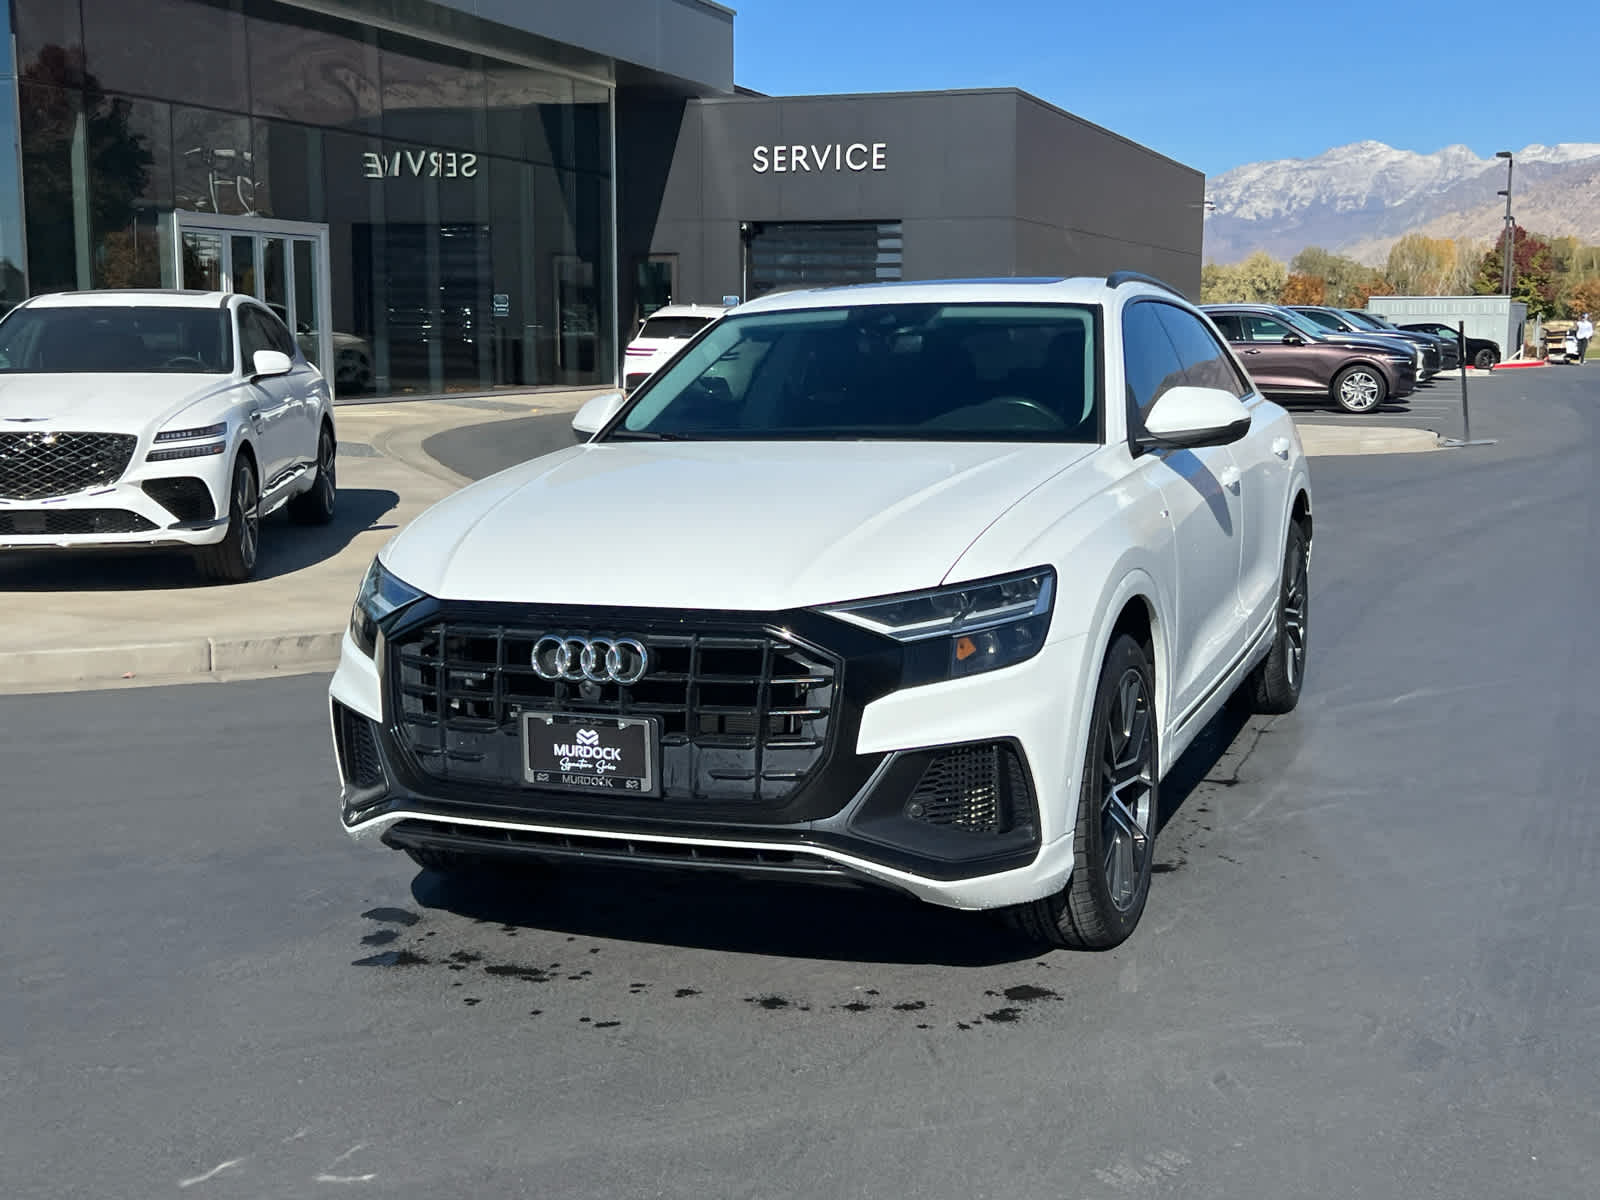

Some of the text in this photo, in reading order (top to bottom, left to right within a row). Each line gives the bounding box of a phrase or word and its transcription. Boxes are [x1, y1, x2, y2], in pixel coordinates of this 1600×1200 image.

[752, 143, 887, 173] SERVICE
[553, 743, 621, 761] MURDOCK
[561, 774, 614, 788] MURDOCK
